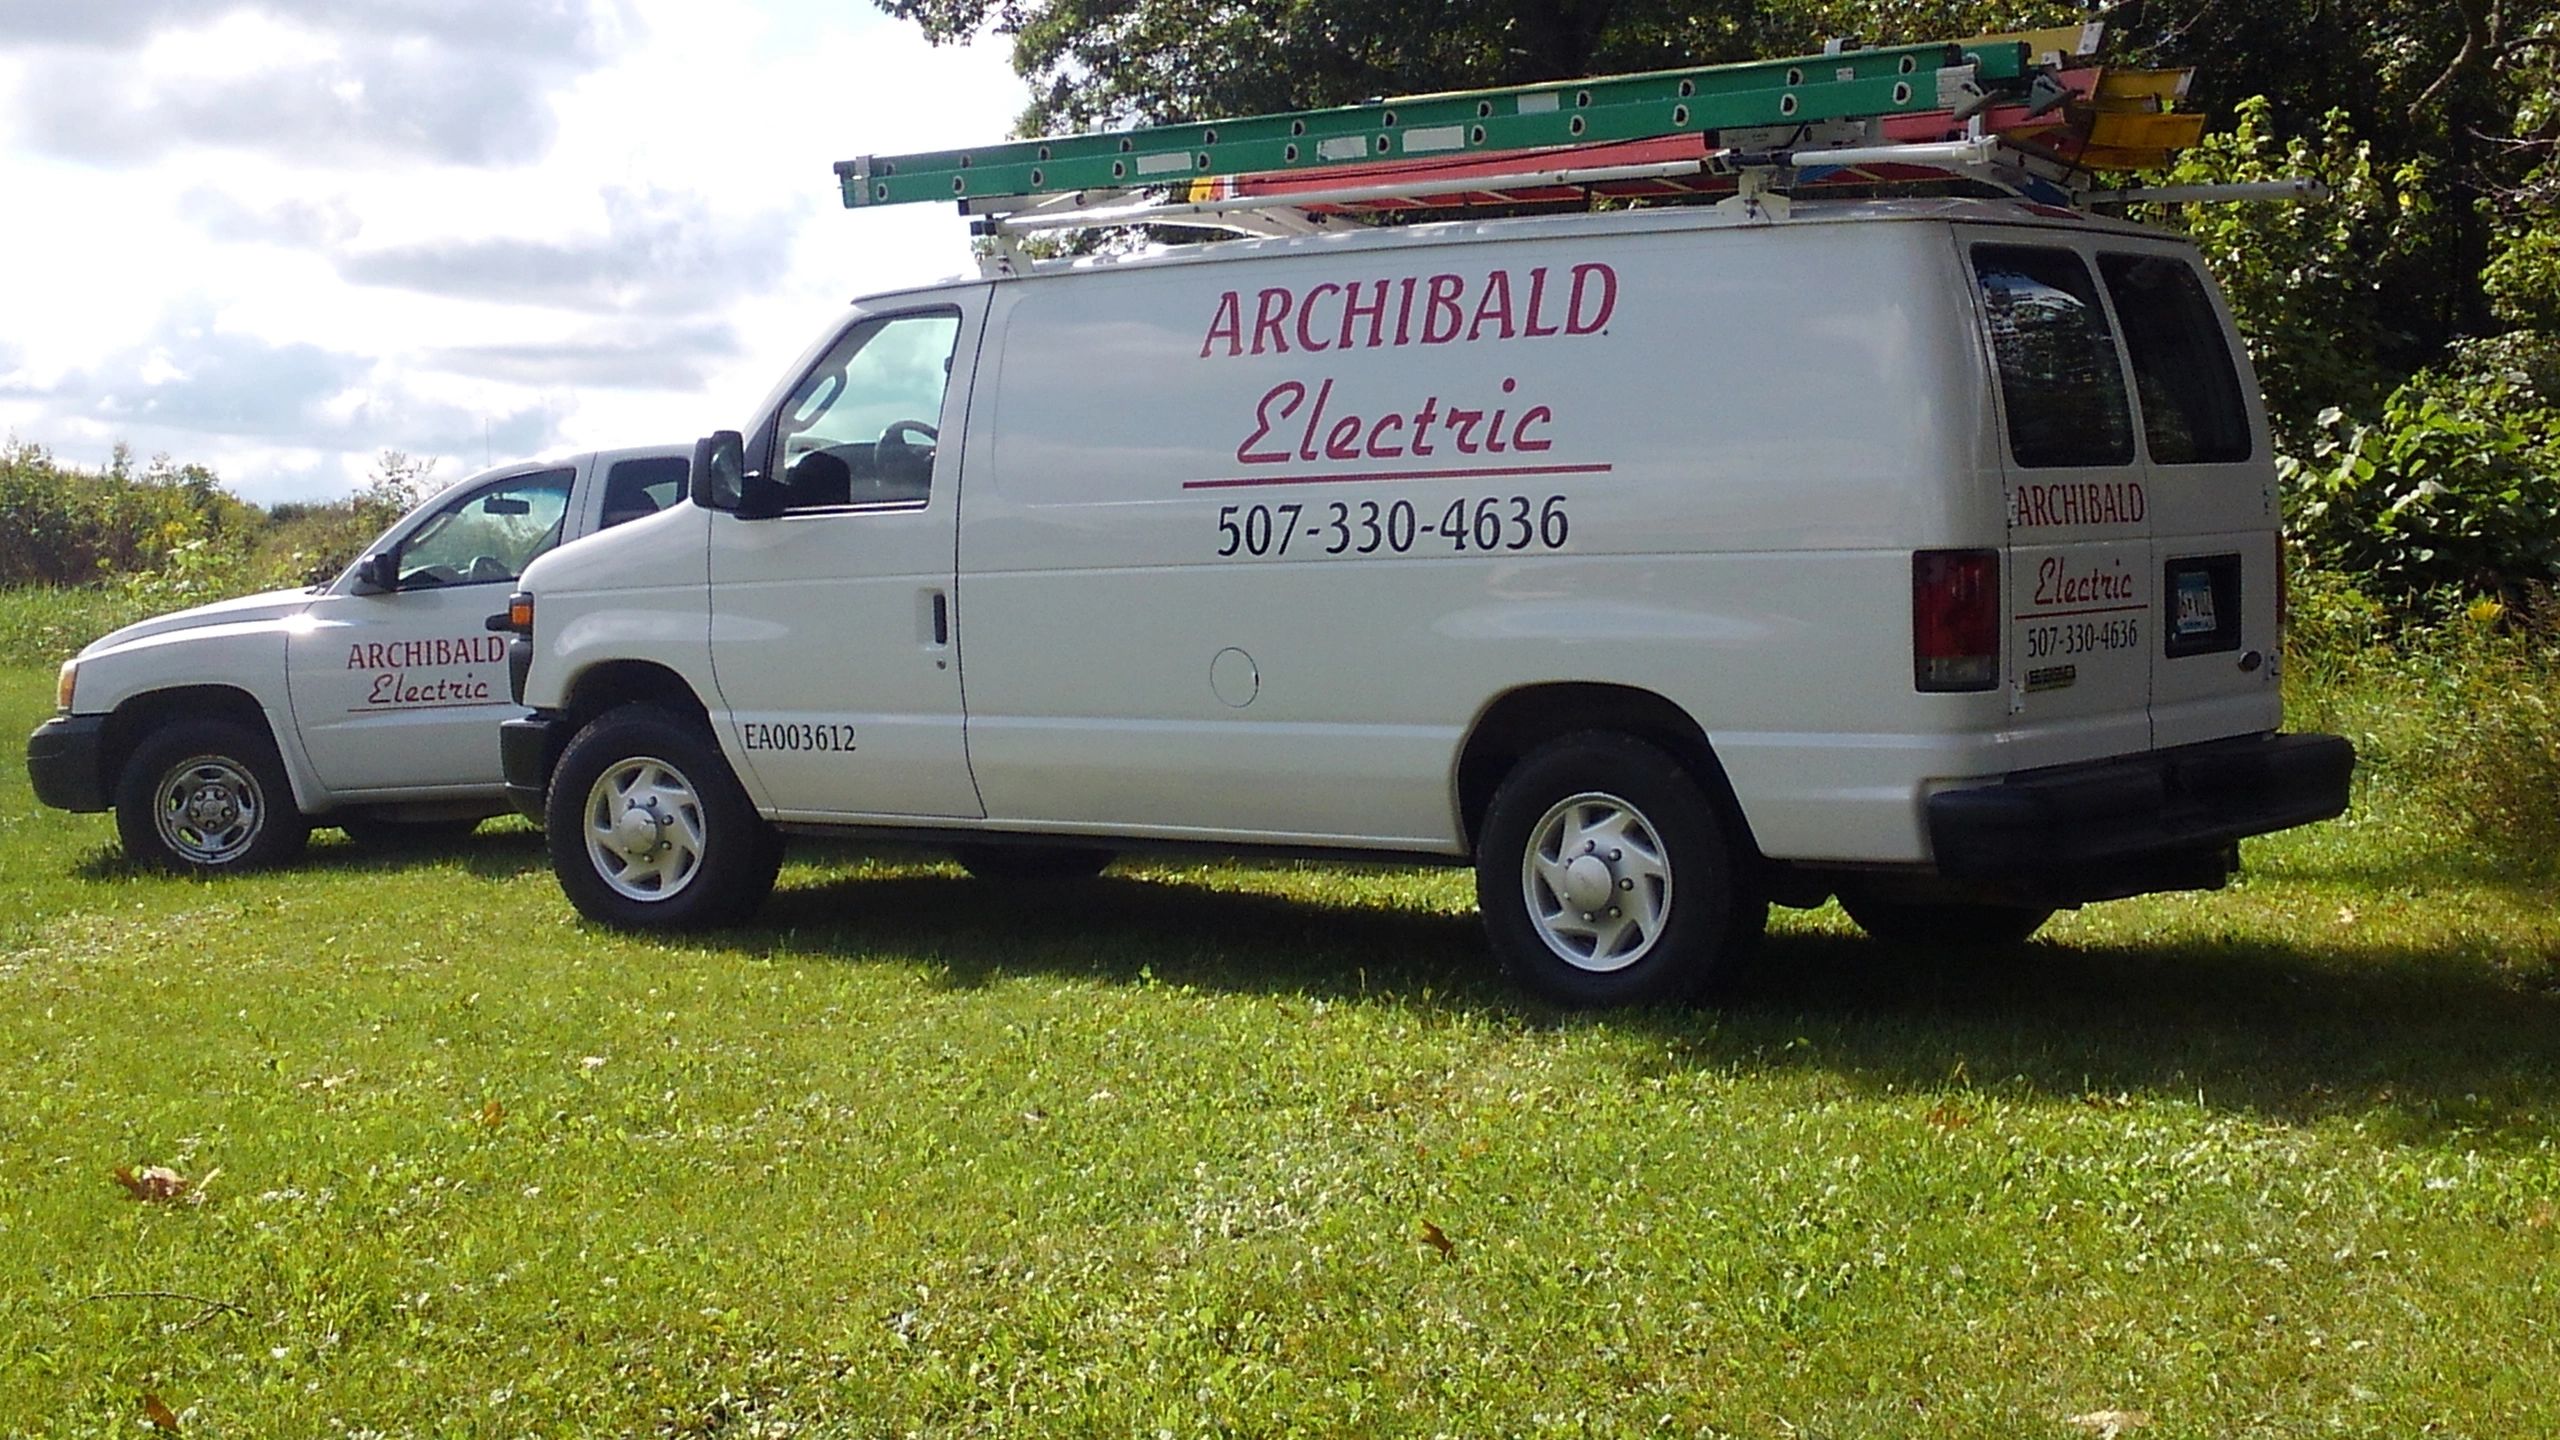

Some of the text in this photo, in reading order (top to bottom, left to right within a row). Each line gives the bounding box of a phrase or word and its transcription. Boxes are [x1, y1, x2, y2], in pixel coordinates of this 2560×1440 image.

[1201, 262, 1618, 358] ARCHIBALD
[1237, 378, 1553, 463] Electric
[1217, 495, 1569, 557] 507-330-4636
[2017, 482, 2145, 527] ARCHIBALD
[2034, 557, 2133, 605] Electric
[347, 635, 505, 670] ARCHIBALD
[2027, 619, 2138, 658] 507-330-4636
[367, 672, 489, 704] Electric
[744, 723, 857, 752] EA003612
